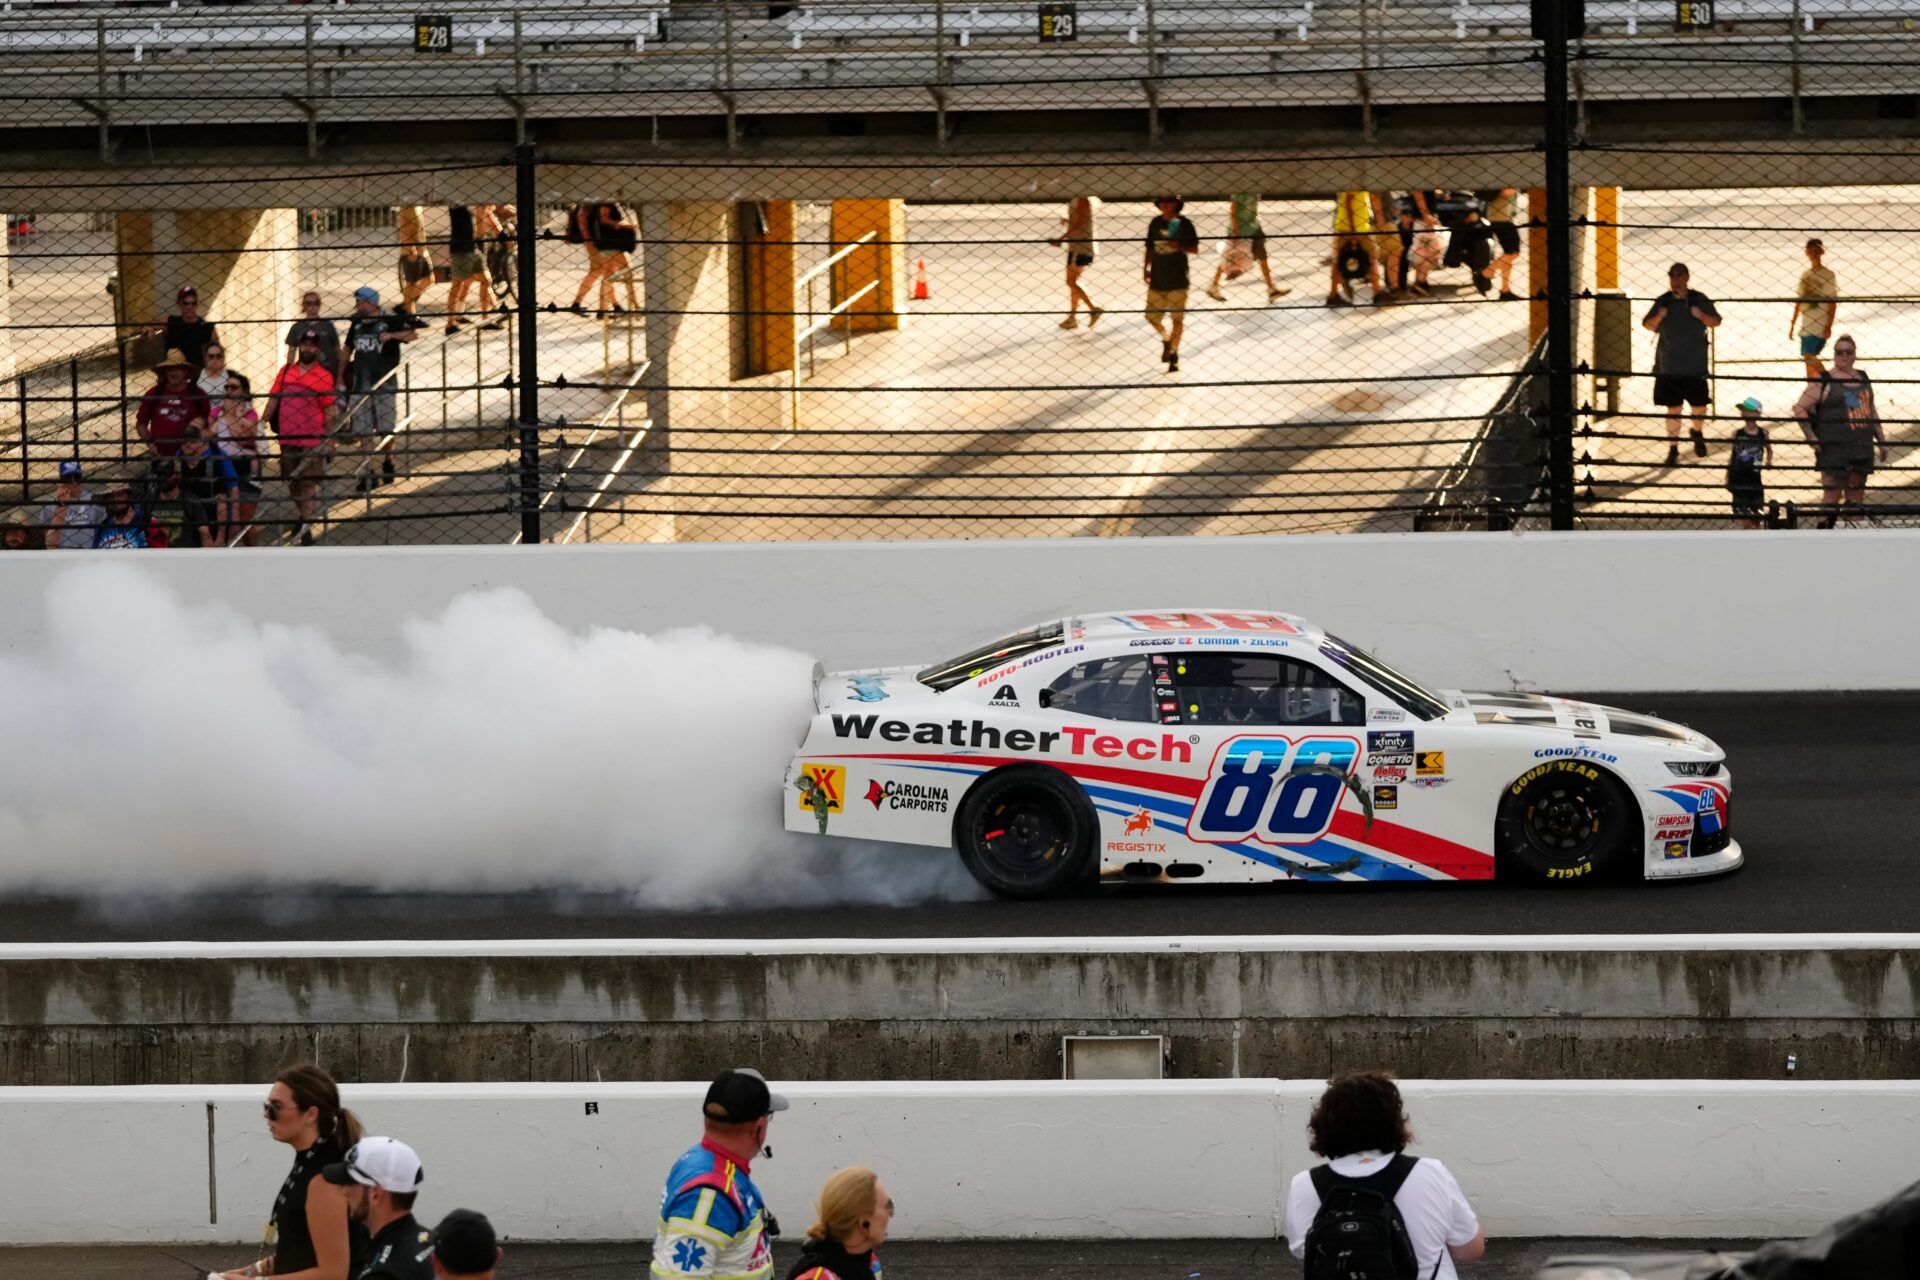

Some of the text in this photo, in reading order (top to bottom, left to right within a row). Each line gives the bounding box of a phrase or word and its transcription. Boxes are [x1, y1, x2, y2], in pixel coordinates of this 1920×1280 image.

[1690, 2, 1711, 24] 30
[1053, 14, 1072, 36] 29
[429, 26, 447, 47] 28
[1198, 637, 1289, 647] CONNOR ZILISCH
[977, 644, 1085, 688] ROTO-ROOTER
[831, 713, 1192, 763] WeatherTech
[1375, 736, 1407, 748] xfinity
[1368, 754, 1413, 764] COMETIC
[884, 780, 949, 801] CAROLINA
[1198, 737, 1357, 835] 88
[804, 797, 839, 808] KA
[890, 796, 948, 813] CARPORTS
[1699, 787, 1715, 810] 88
[1658, 816, 1692, 827] SIMPSON
[1654, 829, 1693, 840] ARP
[1107, 842, 1166, 852] REGISTIX
[1546, 862, 1592, 878] EAGLE
